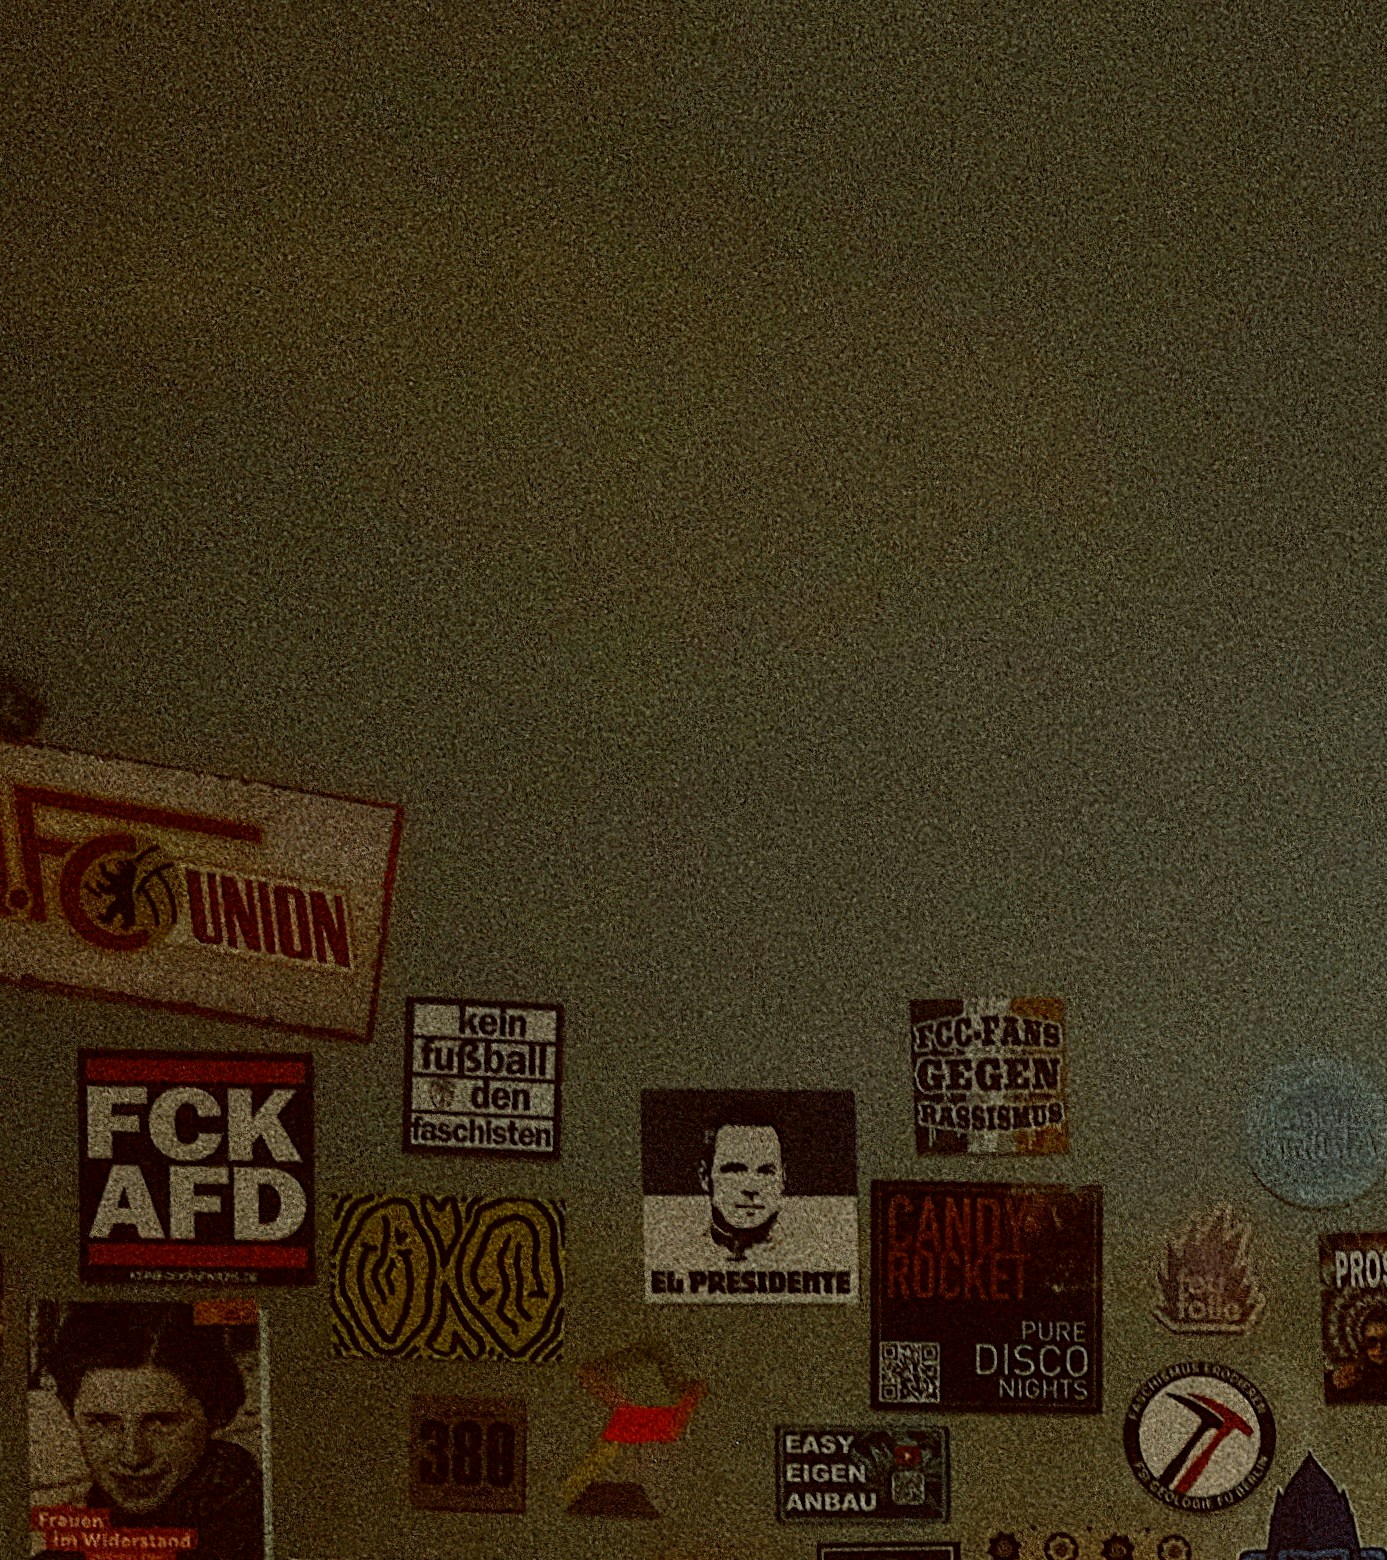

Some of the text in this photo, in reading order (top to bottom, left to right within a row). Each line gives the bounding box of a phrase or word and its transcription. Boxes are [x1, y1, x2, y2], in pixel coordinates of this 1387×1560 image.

[186, 869, 350, 968] UNION
[458, 1006, 526, 1037] kein
[420, 1040, 547, 1077] fußball
[916, 1057, 1060, 1092] GEGEN
[471, 1078, 530, 1112] den
[86, 1084, 303, 1164] FCK
[917, 1101, 1063, 1131] RASSISMUS
[410, 1116, 552, 1150] faschisten
[88, 1164, 308, 1242] AFD
[886, 1197, 1028, 1249] CANDY
[689, 1270, 851, 1294] PRESIDENTE
[887, 1249, 1027, 1300] ROCKET
[1021, 1320, 1086, 1341] PURE
[974, 1342, 1089, 1378] DISCO
[998, 1378, 1088, 1400] NIGHTS
[785, 1434, 855, 1455] EASY
[785, 1463, 867, 1485] EIGEN
[785, 1491, 877, 1512] ANBAU
[38, 1511, 104, 1528] Frauen
[53, 1531, 191, 1548] im Widerstand
